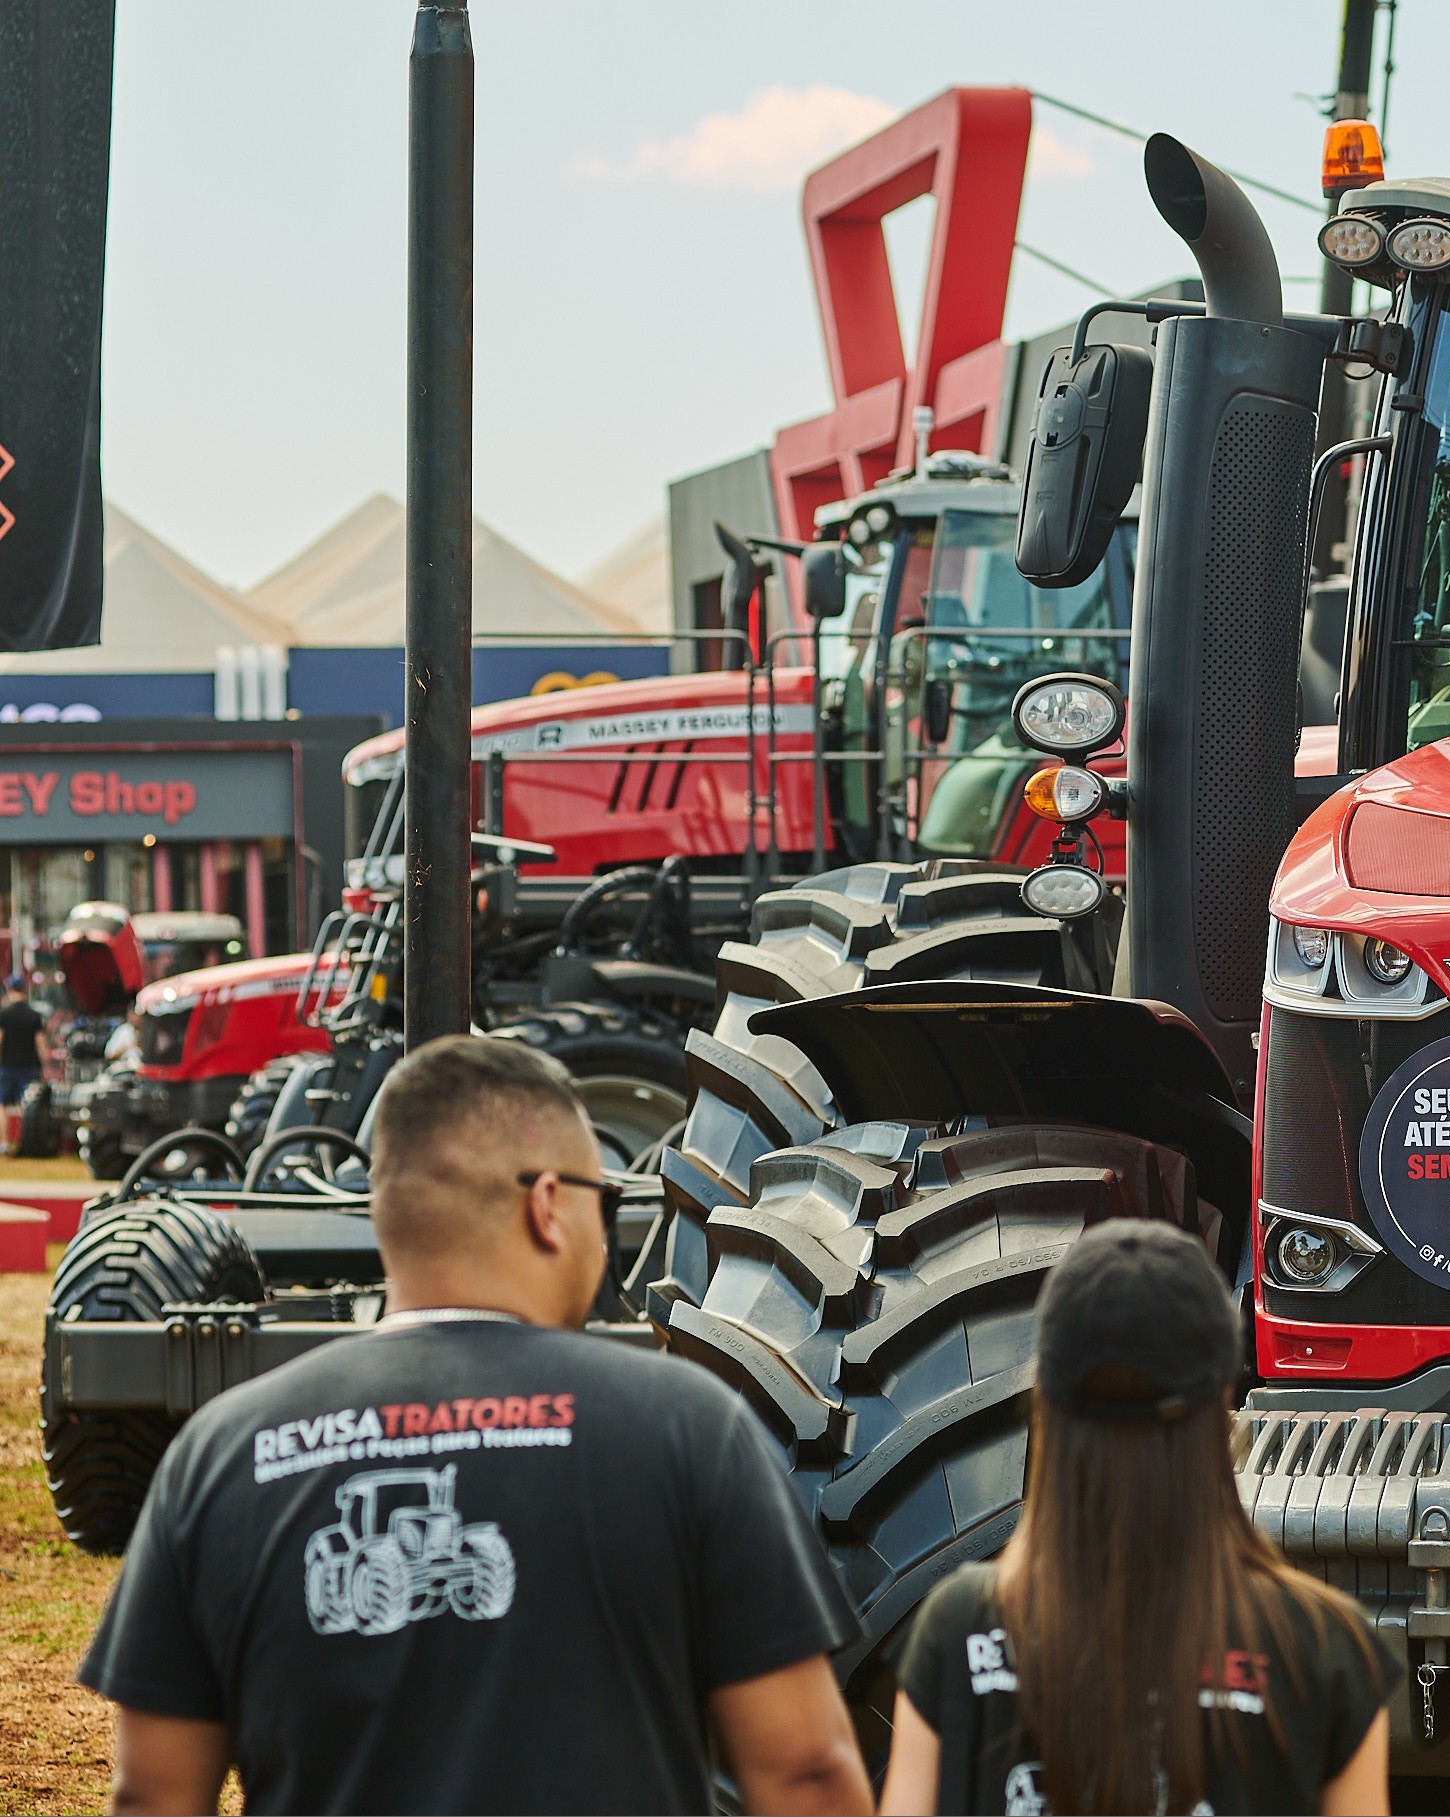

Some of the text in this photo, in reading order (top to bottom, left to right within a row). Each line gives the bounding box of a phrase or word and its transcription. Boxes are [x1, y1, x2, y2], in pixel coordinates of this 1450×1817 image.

[588, 718, 669, 740] MASSEY
[0, 771, 197, 825] EY Shop
[1404, 1115, 1450, 1146] ATÉ
[725, 1333, 747, 1352] 900
[931, 1404, 959, 1423] 900
[254, 1392, 577, 1464] REVISATRATORES
